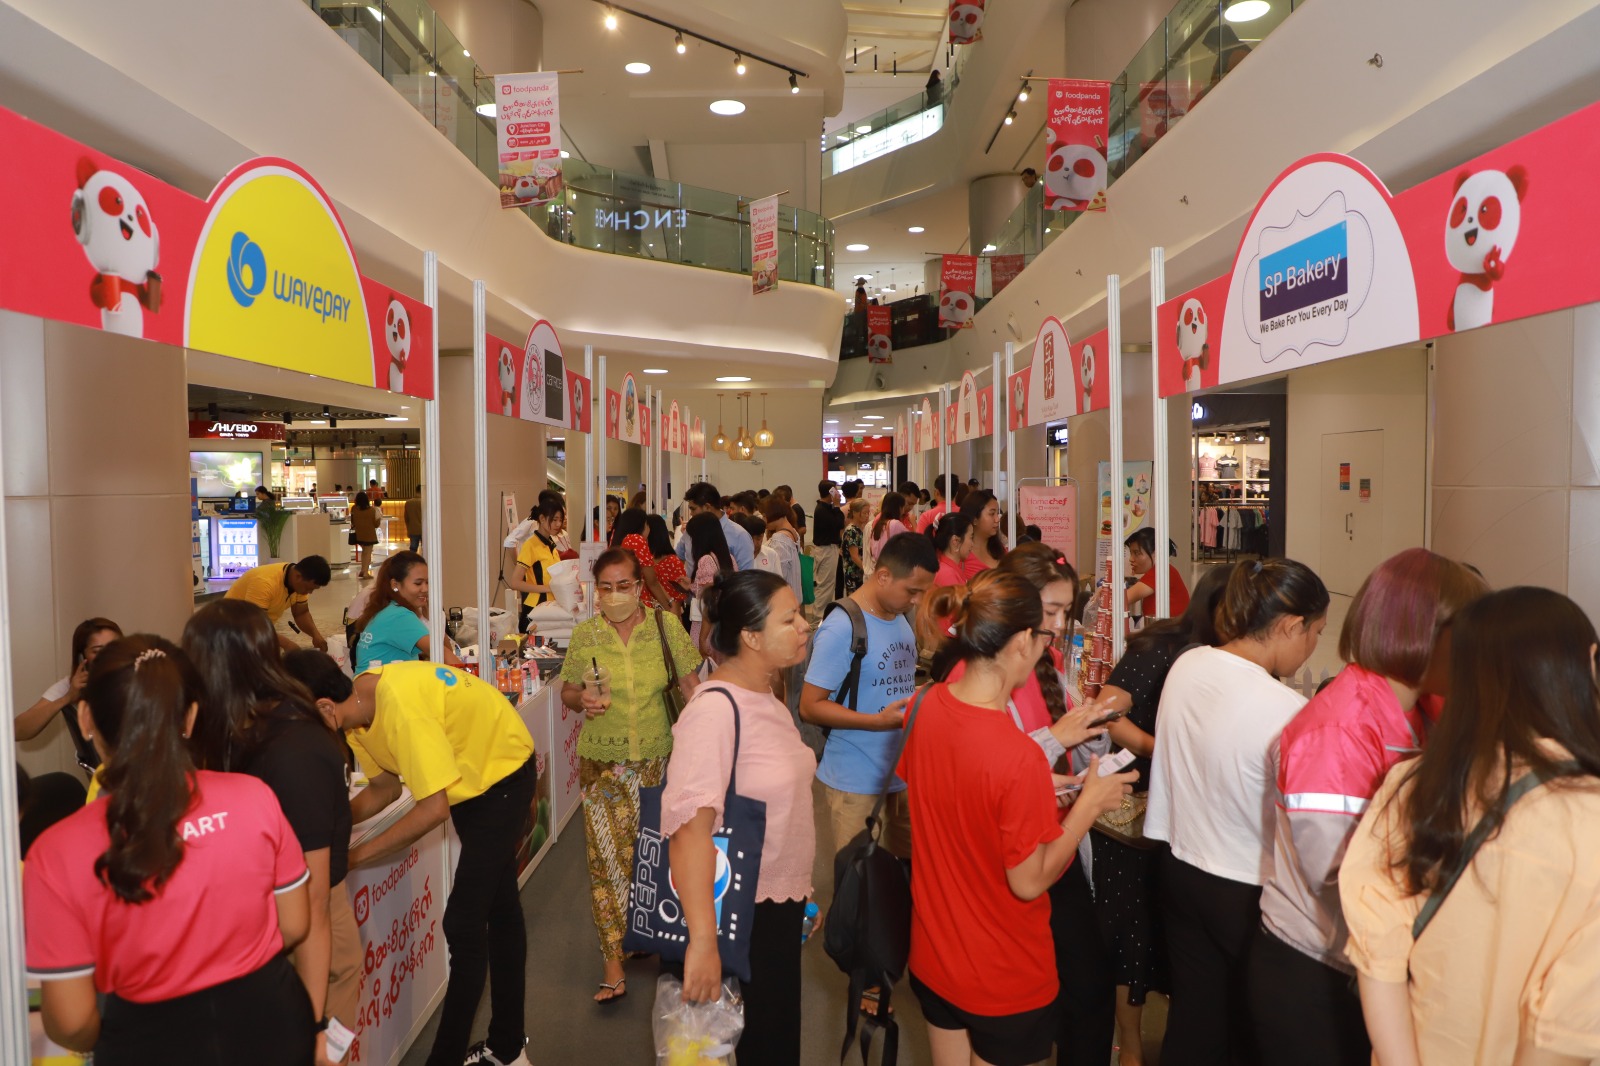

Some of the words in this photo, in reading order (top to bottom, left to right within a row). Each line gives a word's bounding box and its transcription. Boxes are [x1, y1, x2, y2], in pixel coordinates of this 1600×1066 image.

[513, 84, 549, 95] foodpanda
[1065, 91, 1101, 100] foodpanda
[1264, 270, 1283, 298] SP
[1286, 253, 1341, 290] Bakery
[1260, 323, 1269, 334] We
[1270, 318, 1285, 330] Bake
[1286, 314, 1297, 326] For
[1298, 309, 1311, 322] You
[1312, 303, 1332, 318] Every
[1333, 298, 1349, 312] Day
[207, 422, 258, 433] SHISEIDO
[177, 812, 228, 842] ART
[371, 847, 419, 907] foodpanda
[632, 826, 662, 939] PEPSI
